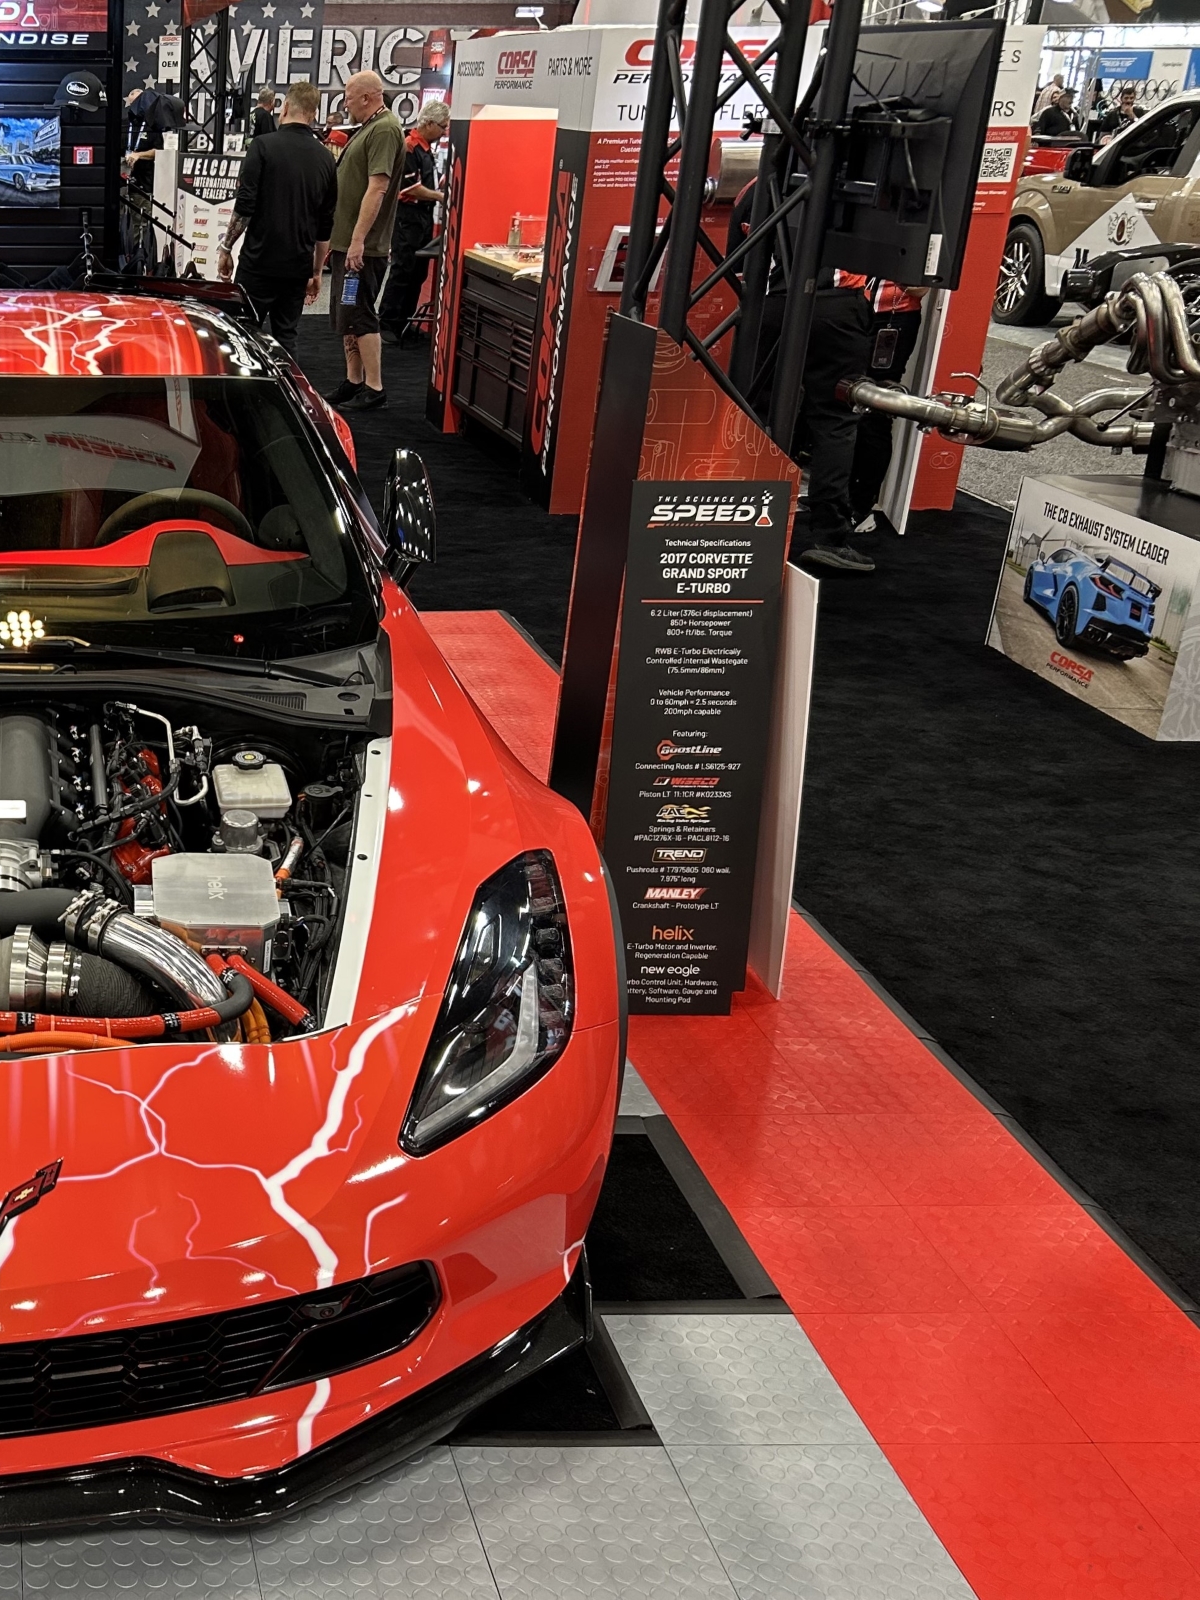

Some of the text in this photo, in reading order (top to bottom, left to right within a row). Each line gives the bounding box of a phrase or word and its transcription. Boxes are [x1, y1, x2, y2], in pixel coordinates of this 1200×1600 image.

[498, 50, 537, 77] CORSA
[548, 58, 568, 76] PARTS
[574, 57, 592, 76] MORE
[457, 61, 484, 77] ACCESSORIES
[494, 80, 533, 90] PERFORMANCE
[193, 177, 237, 189] INTERNATIONAL
[202, 189, 227, 200] DEALERS
[650, 505, 756, 521] SPEED
[1044, 502, 1169, 565] THE C8 EXHAUST SYSTEM LEADER
[700, 539, 751, 547] Specifications
[660, 553, 753, 564] 2017 CORVETTE
[663, 568, 748, 578] GRAND SPORT
[677, 583, 730, 593] E-TURBO
[703, 610, 752, 618] displacement)
[709, 629, 732, 637] Torque
[702, 648, 741, 656] Electrically
[711, 658, 748, 666] Wastegate
[1050, 651, 1094, 682] CORSA
[1046, 662, 1089, 689] PERFORMANCE
[694, 708, 721, 716] capable
[673, 730, 708, 738] Featuring:
[635, 763, 674, 771] Connecting
[657, 850, 703, 860] TREND
[206, 875, 228, 900] helix
[644, 888, 702, 899] MANLEY
[676, 902, 709, 910] Prototype
[652, 925, 694, 940] helix
[635, 952, 708, 960] Regeneration Capable
[640, 964, 700, 977] new eagle
